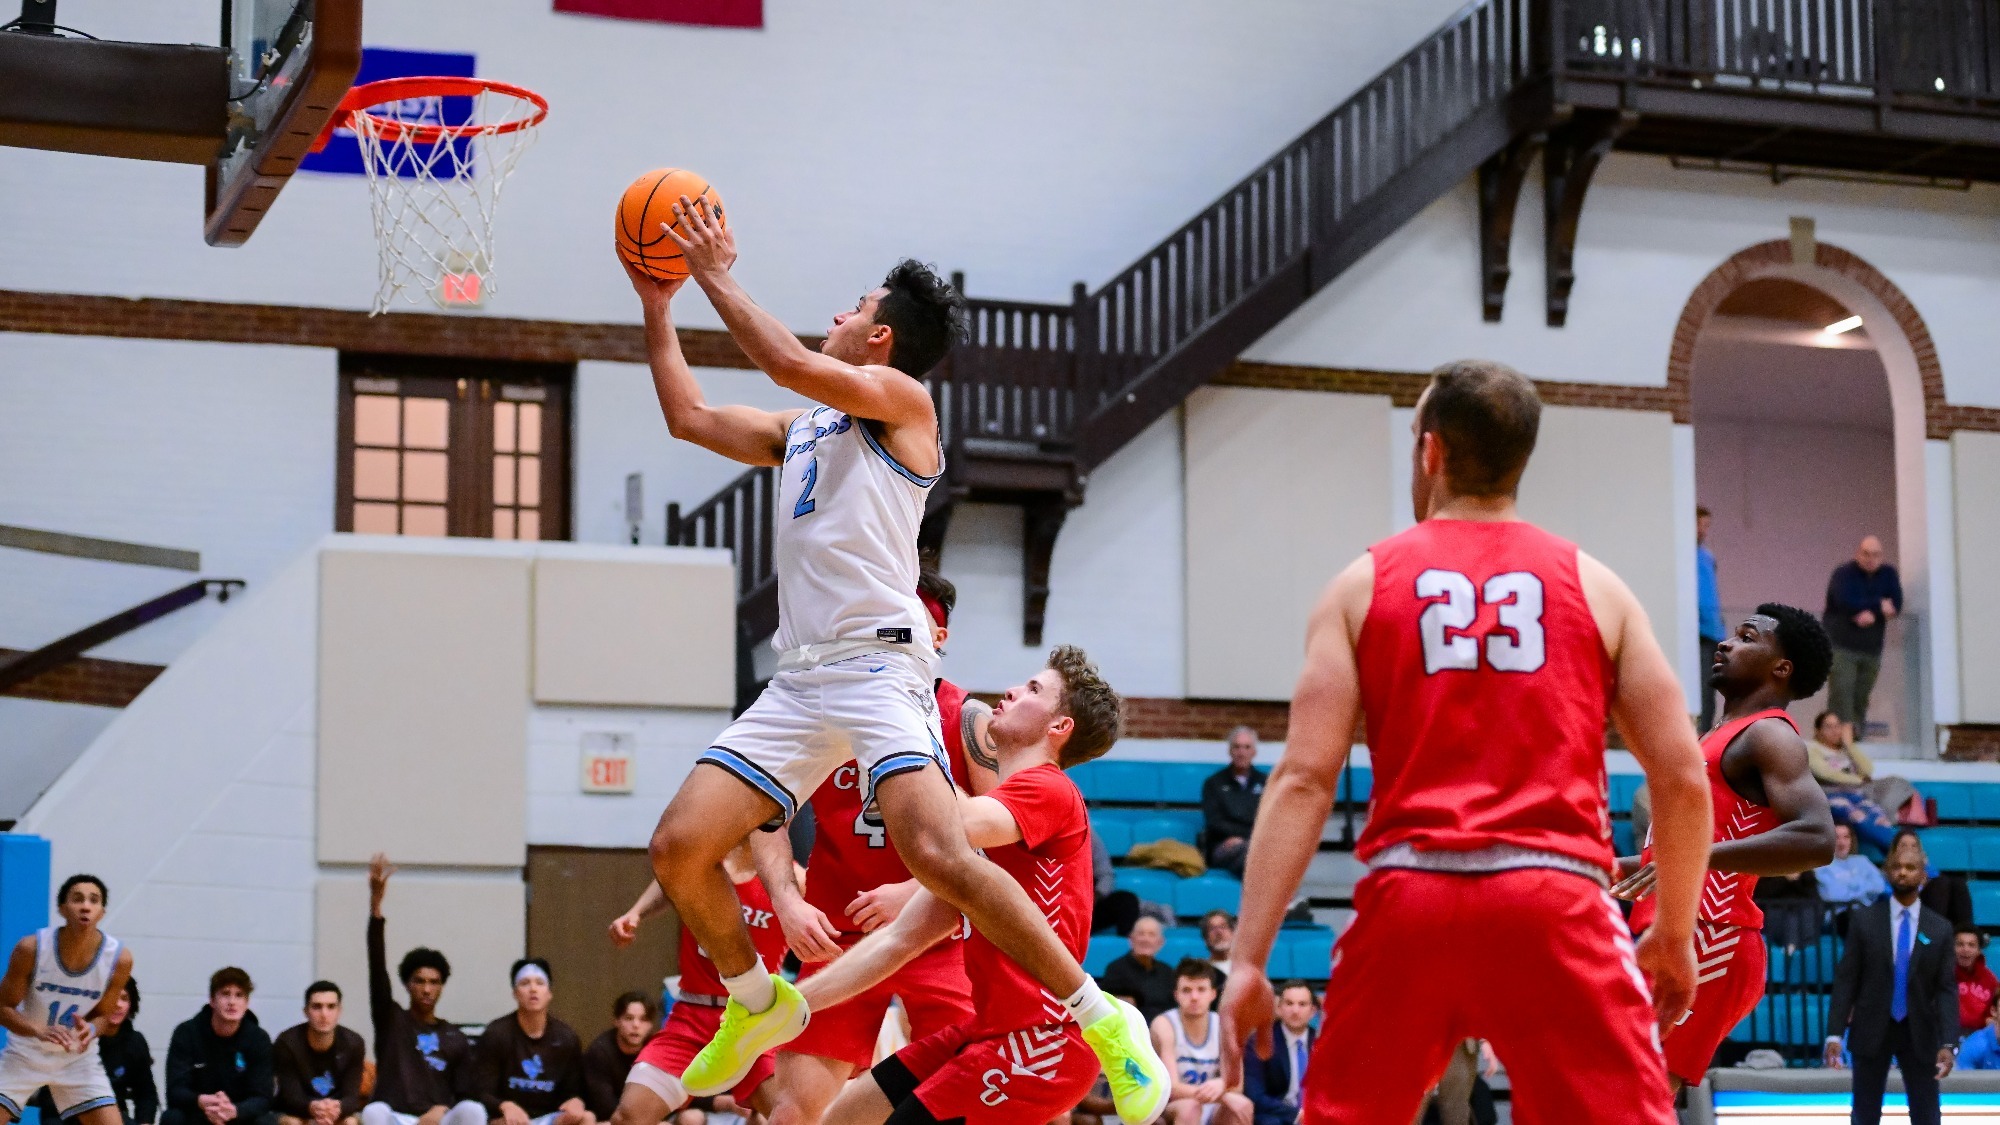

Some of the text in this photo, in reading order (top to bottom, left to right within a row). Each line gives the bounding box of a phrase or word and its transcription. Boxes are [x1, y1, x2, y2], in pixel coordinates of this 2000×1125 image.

[793, 457, 818, 519] 2
[1414, 567, 1546, 675] 23
[591, 757, 627, 787] EXIT
